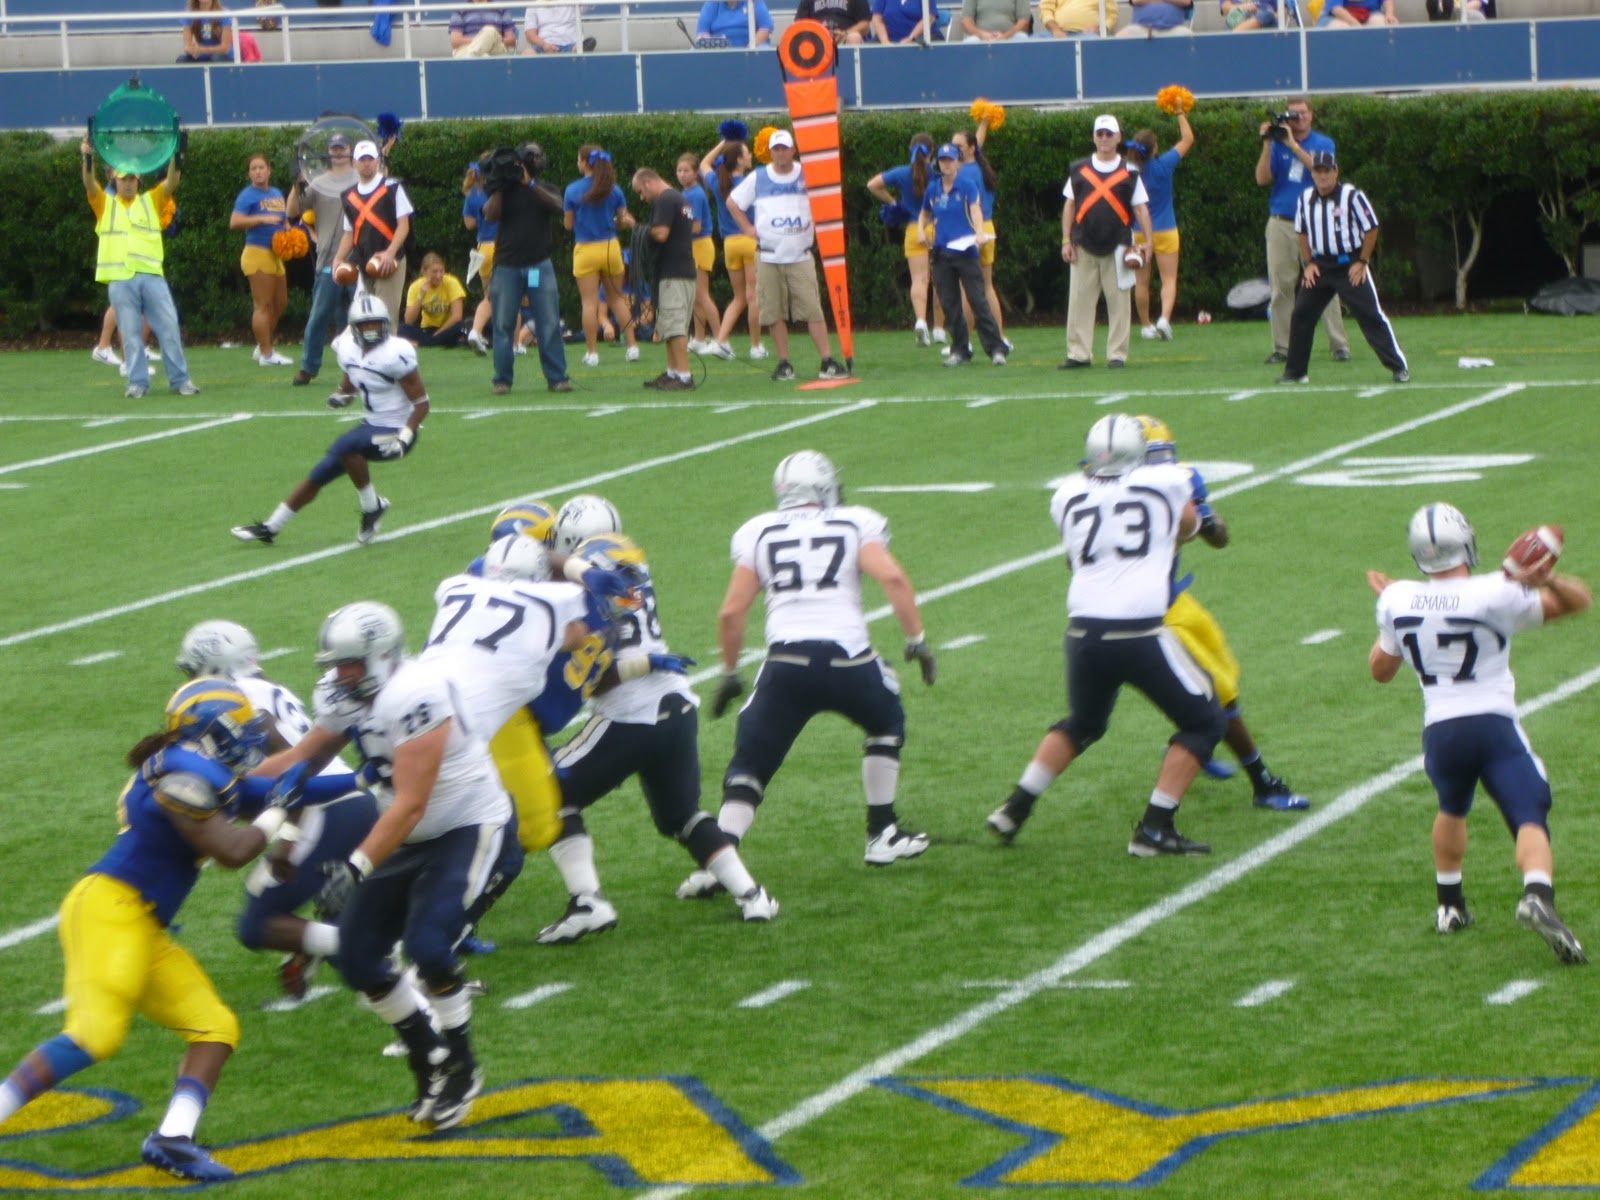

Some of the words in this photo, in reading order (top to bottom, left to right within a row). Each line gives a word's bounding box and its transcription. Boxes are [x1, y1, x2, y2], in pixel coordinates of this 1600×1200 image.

[771, 216, 803, 229] CAA
[1071, 500, 1151, 566] 73
[767, 535, 847, 593] 57
[431, 592, 526, 655] 77
[1410, 594, 1460, 612] DEMARCO
[1402, 631, 1480, 688] 17
